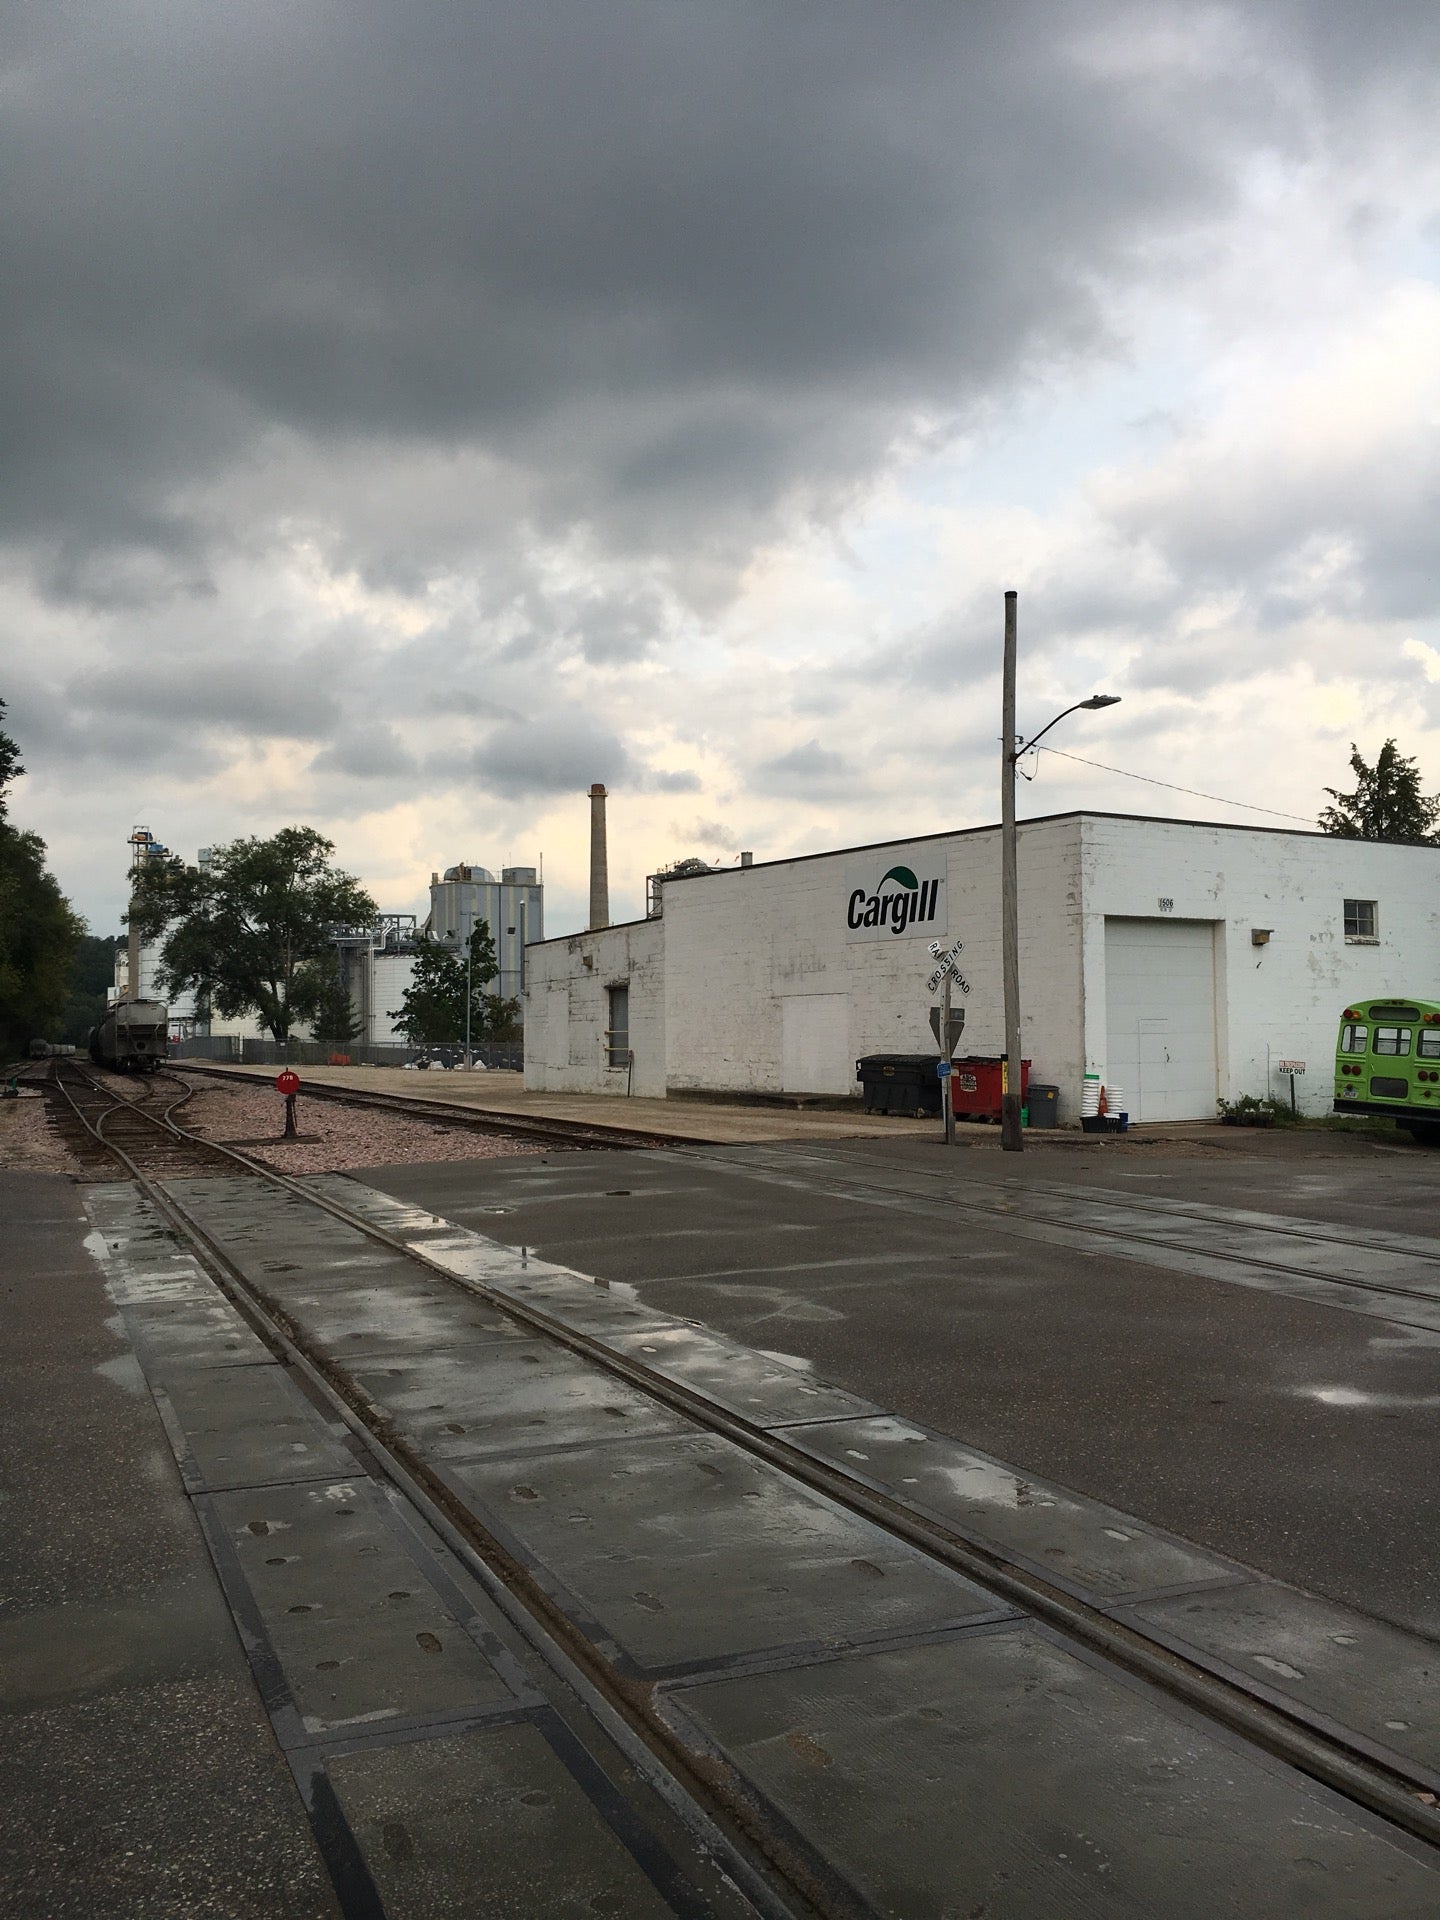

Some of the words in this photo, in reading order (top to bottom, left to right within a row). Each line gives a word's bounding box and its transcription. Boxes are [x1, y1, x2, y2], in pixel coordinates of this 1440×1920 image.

[847, 879, 939, 935] Cargill
[928, 941, 963, 991] CROSSING
[951, 969, 970, 993] ROAD
